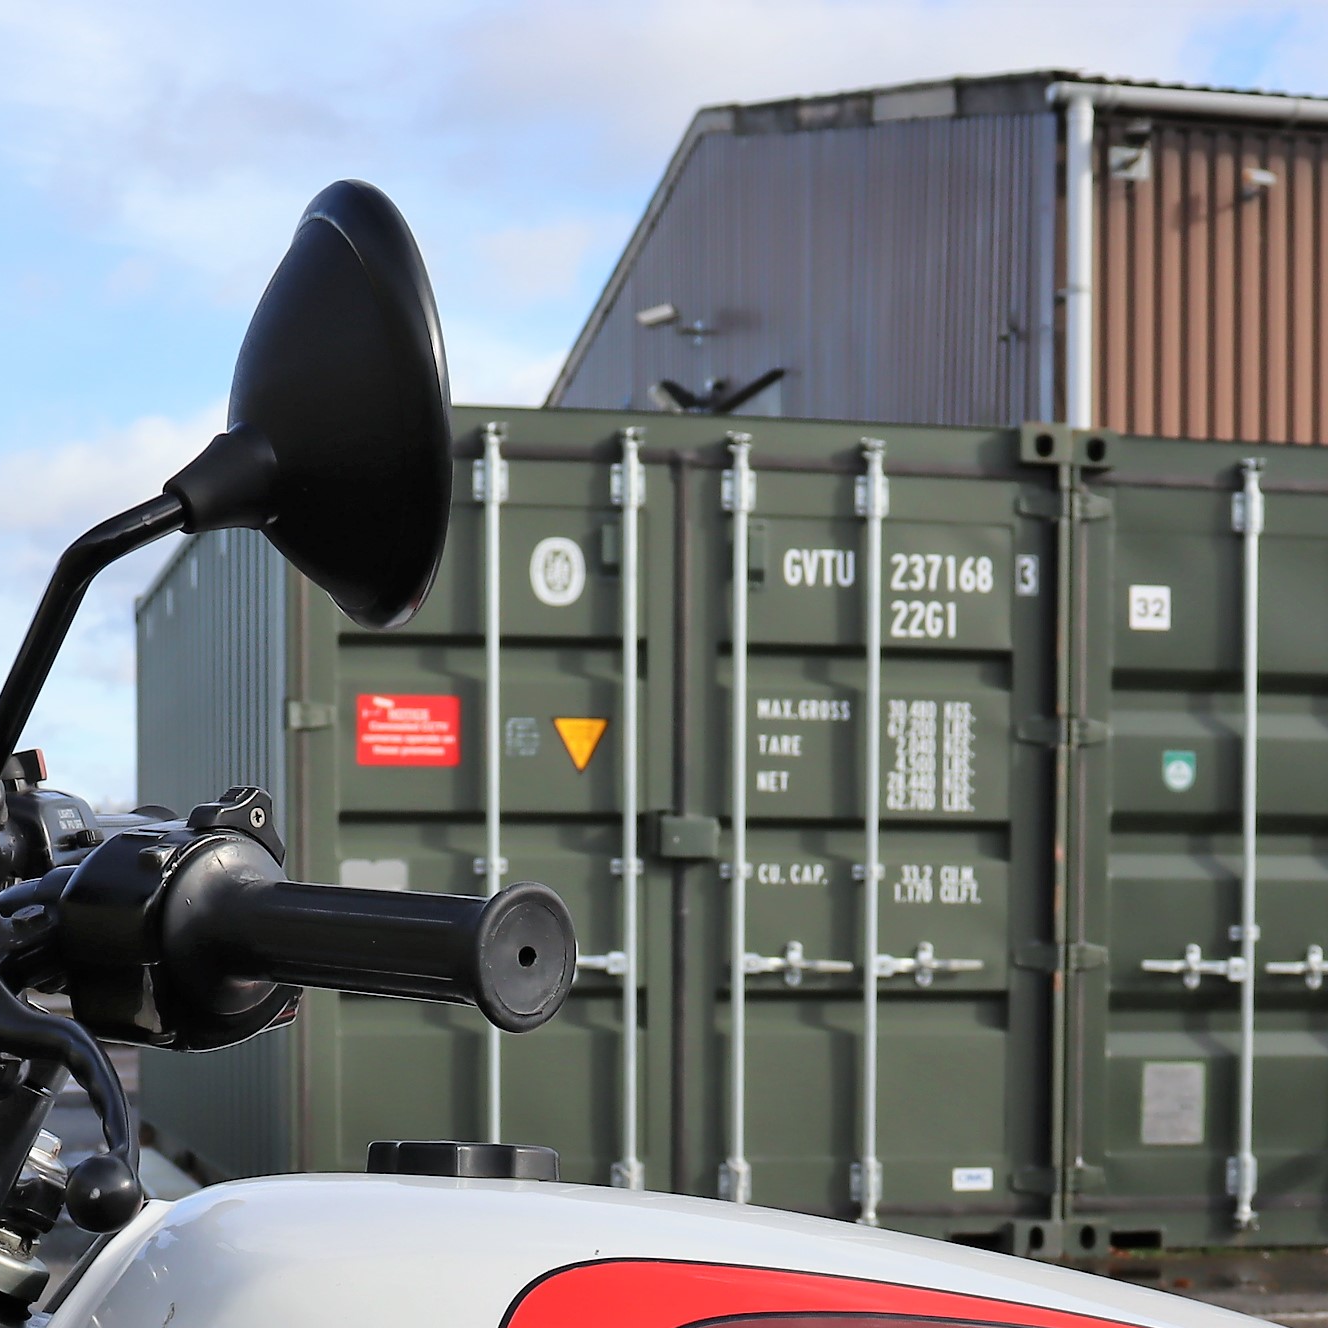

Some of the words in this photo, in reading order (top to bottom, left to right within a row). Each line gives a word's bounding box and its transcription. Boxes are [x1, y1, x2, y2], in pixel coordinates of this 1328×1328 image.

[783, 548, 856, 587] GVTU
[889, 553, 994, 593] 237168
[1018, 556, 1037, 594] 3
[1136, 597, 1165, 618] 32
[890, 599, 958, 639] 22G1
[757, 698, 851, 721] MAX.GROSS
[759, 735, 802, 757] TARE
[757, 771, 789, 793] NET
[758, 863, 786, 884] CU.
[790, 864, 828, 885] CAP.
